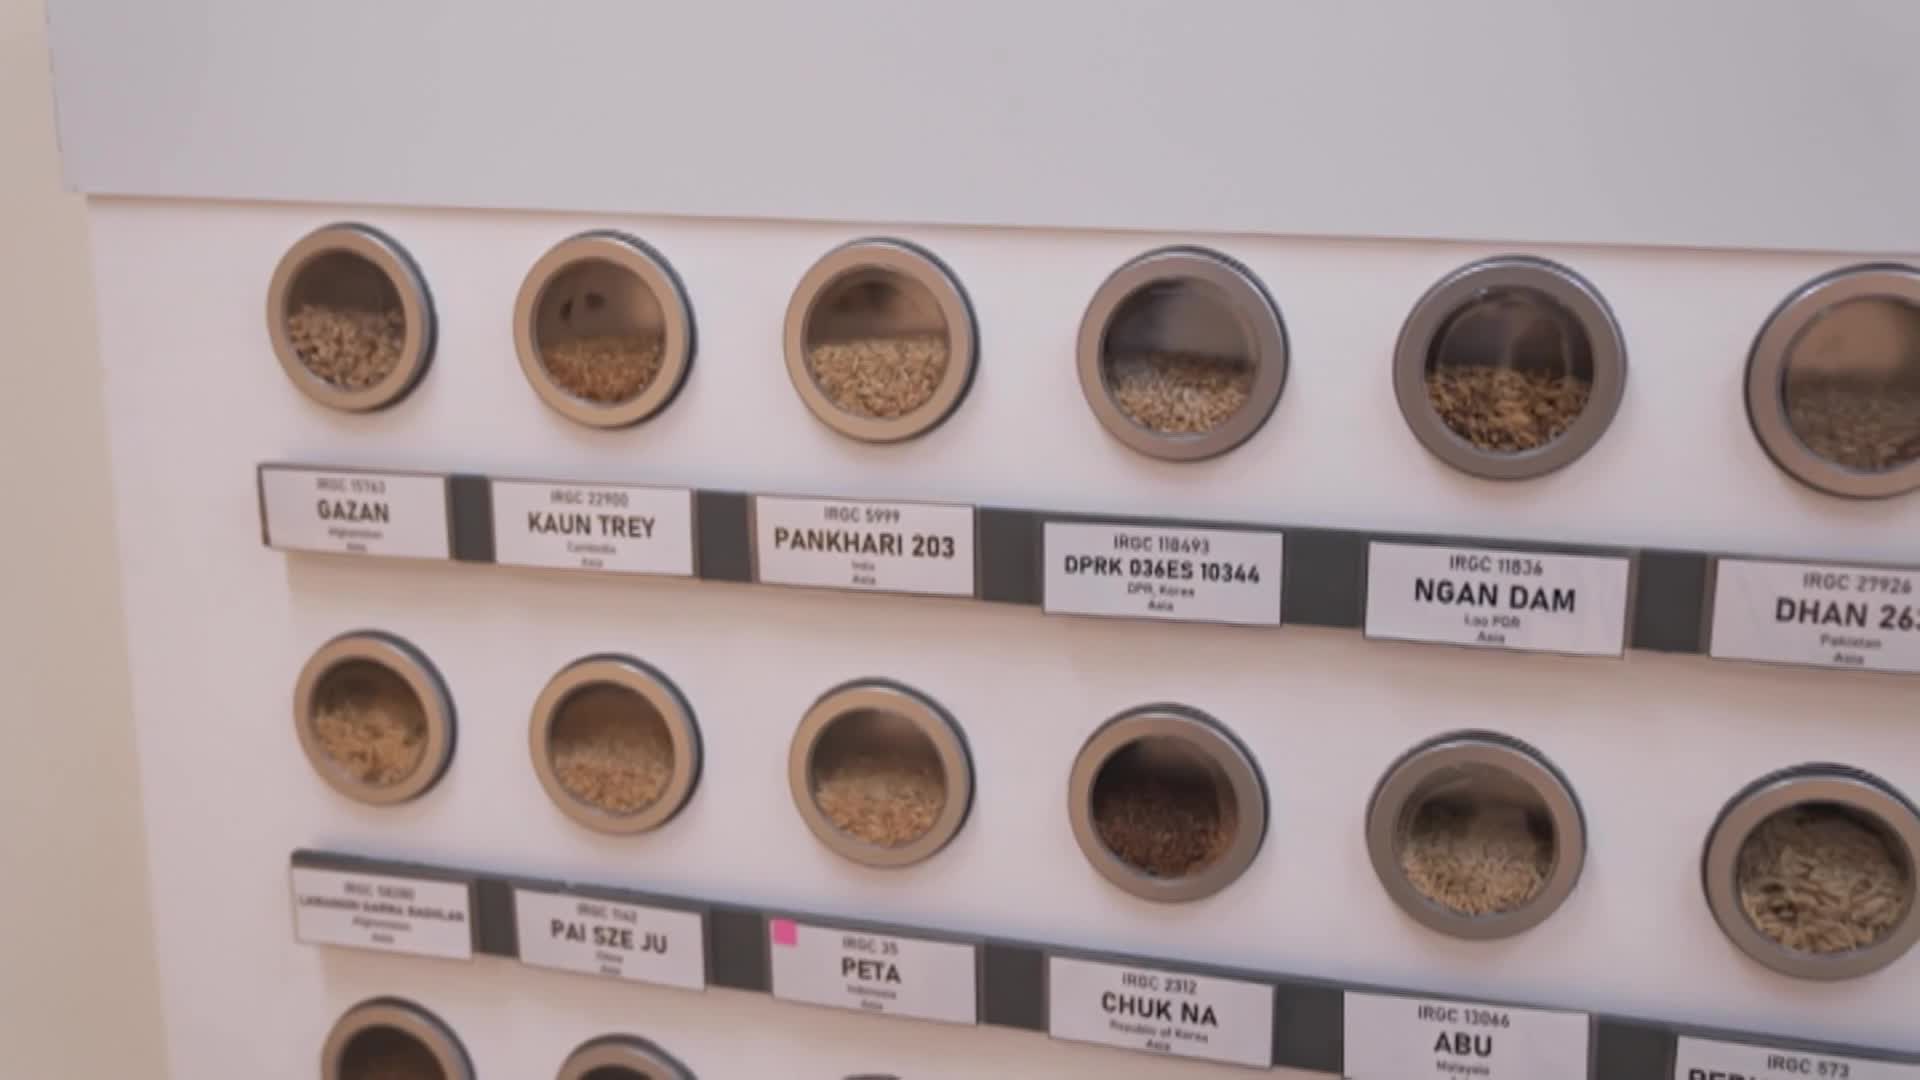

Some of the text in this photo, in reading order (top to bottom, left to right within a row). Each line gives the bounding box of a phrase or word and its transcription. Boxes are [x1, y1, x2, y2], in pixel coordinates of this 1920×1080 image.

[317, 499, 390, 523] GAZAN
[824, 506, 900, 525] IRGC 5999
[528, 511, 656, 539] KAUN TREY
[774, 526, 956, 560] PANKHARI 203
[1113, 534, 1210, 556] IRGC 118493
[1064, 554, 1261, 585] DPRK 036ES 10344
[1450, 555, 1544, 577] IRGC 11836
[1414, 577, 1576, 613] NGAN DAM
[1803, 572, 1913, 595] IRGC 27926
[1776, 595, 1868, 629] DHAN
[551, 918, 669, 955] PAI SZE JU
[842, 936, 876, 953] IRGC
[841, 956, 902, 984] PETA
[1122, 971, 1198, 996] IRGC 2312
[1101, 990, 1218, 1027] CHUK NA
[1418, 1004, 1459, 1024] IRGC
[1433, 1030, 1493, 1058] ABU
[1767, 1054, 1812, 1074] IRGC
[1816, 1059, 1850, 1078] 573
